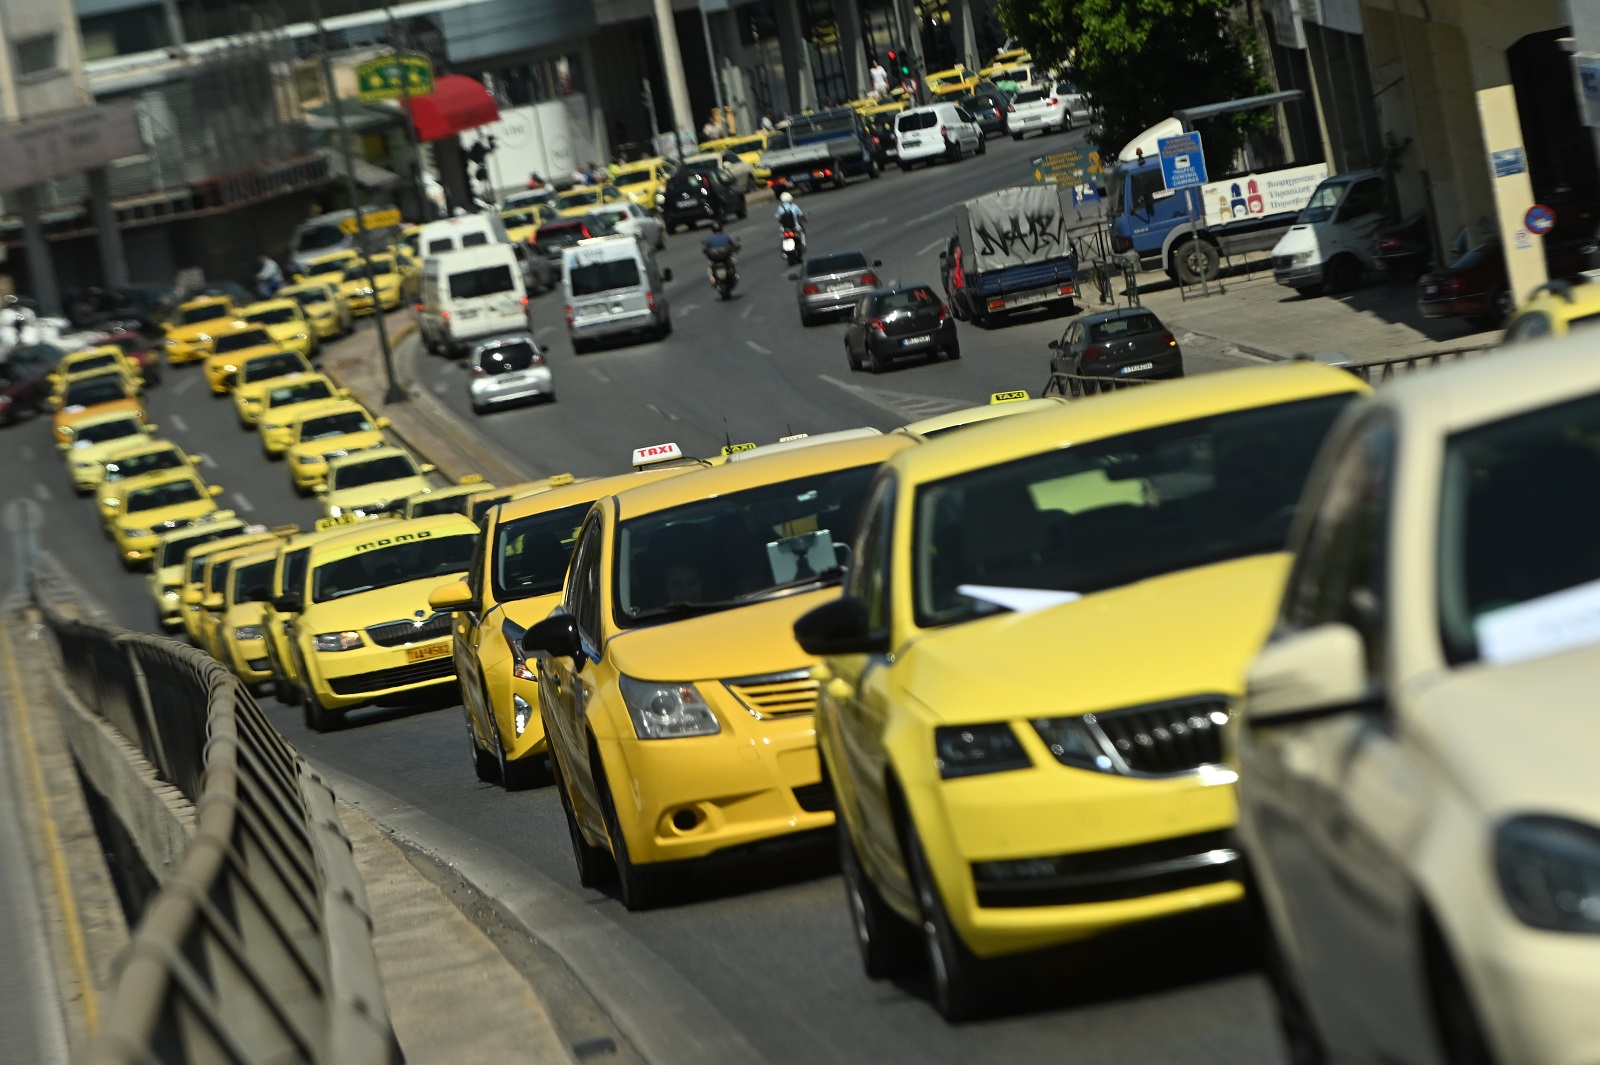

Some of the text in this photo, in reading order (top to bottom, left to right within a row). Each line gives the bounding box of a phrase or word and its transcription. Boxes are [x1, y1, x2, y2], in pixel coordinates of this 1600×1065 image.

[996, 392, 1024, 400] TAXI
[638, 445, 673, 458] TAXI
[356, 531, 431, 551] momo
